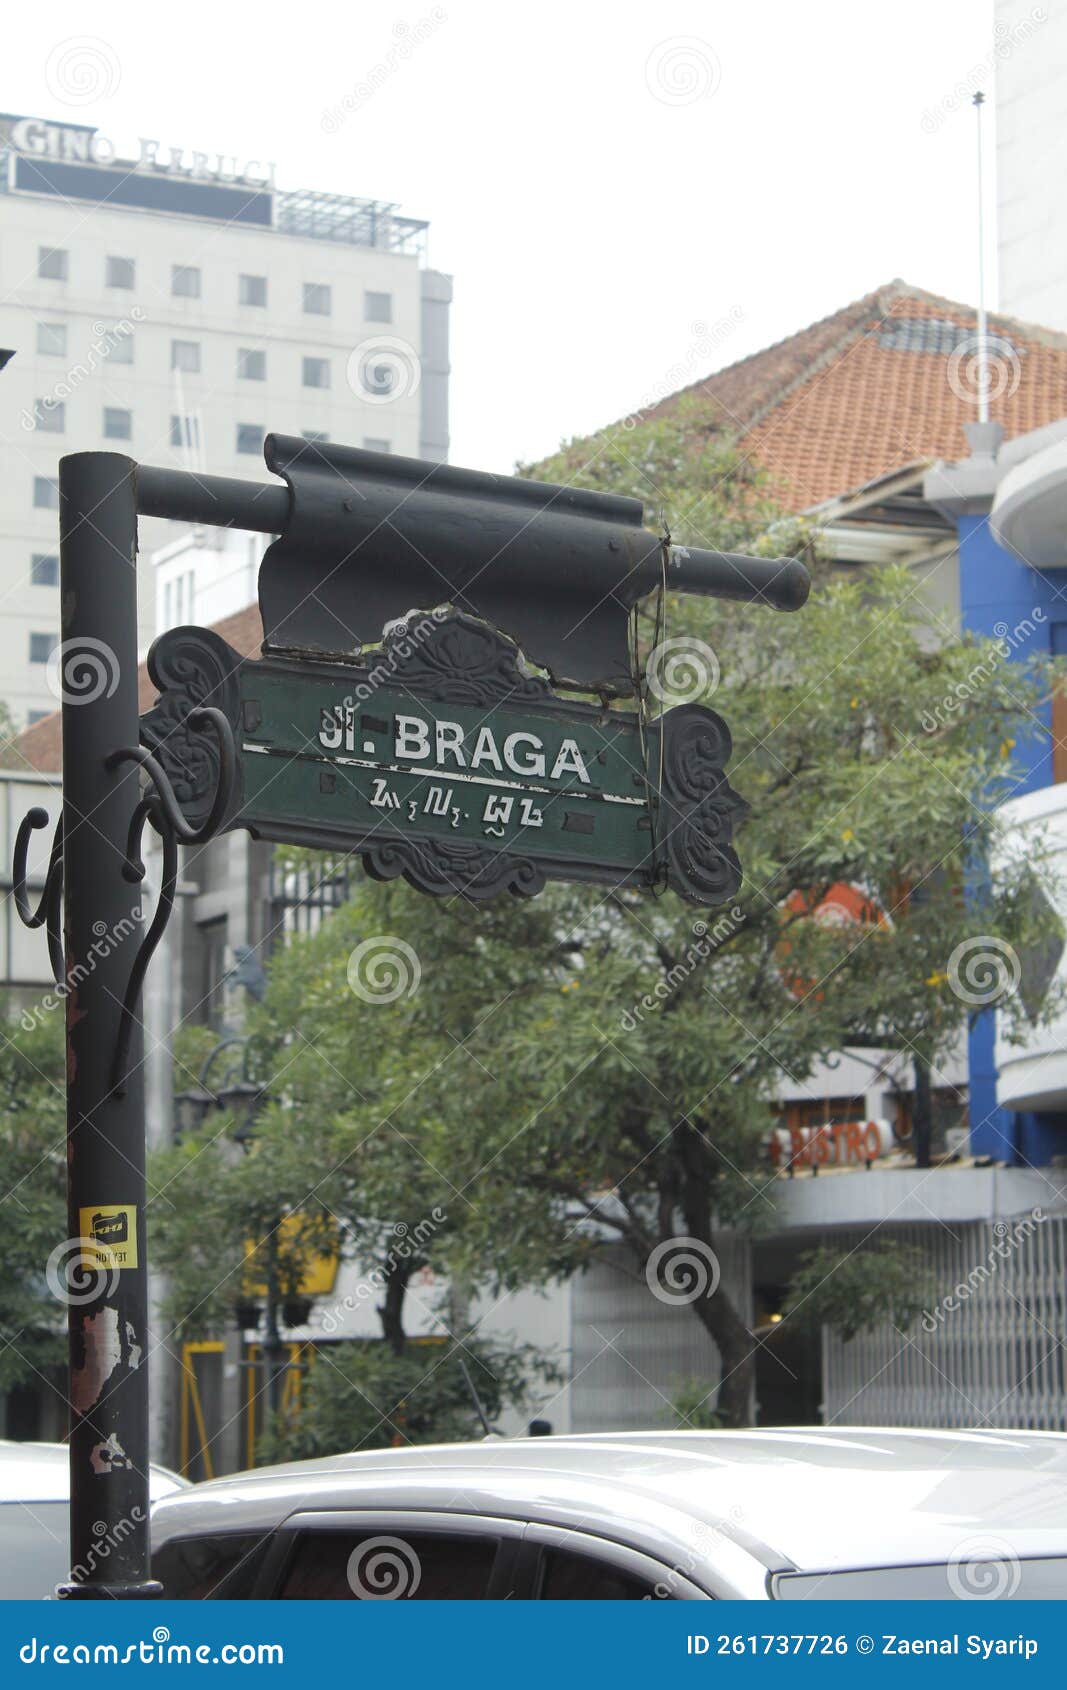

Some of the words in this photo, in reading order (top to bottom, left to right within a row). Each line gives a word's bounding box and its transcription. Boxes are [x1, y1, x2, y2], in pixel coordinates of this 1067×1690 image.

[11, 118, 117, 166] GINO
[318, 705, 376, 754] Jl.
[393, 713, 592, 785] BRAGA
[791, 1120, 881, 1168] BISTRO
